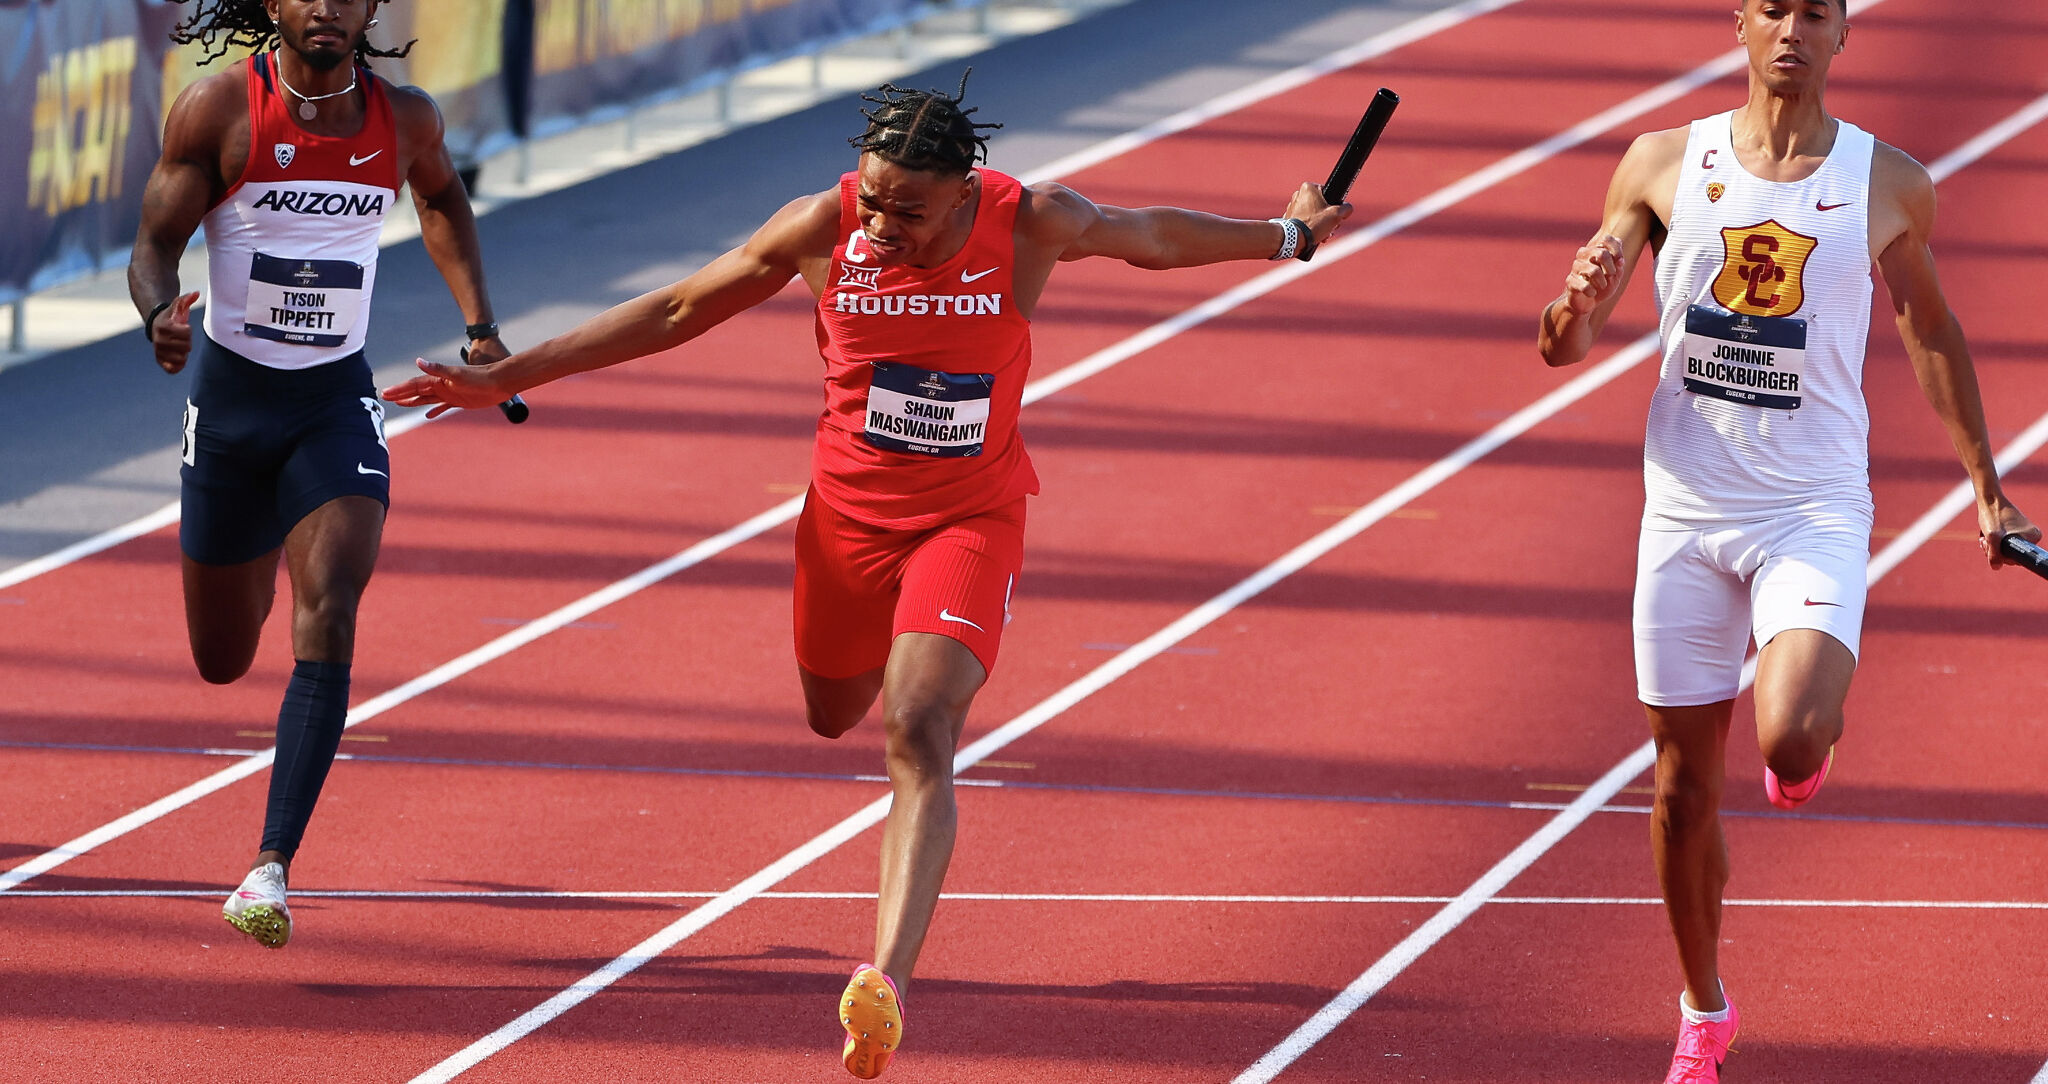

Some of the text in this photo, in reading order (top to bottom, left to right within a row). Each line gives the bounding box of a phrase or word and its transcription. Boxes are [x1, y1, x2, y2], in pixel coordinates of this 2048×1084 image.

[1702, 150, 1717, 169] C
[252, 190, 384, 216] ARIZONA
[845, 229, 867, 263] C
[283, 291, 326, 307] TYSON
[835, 292, 1002, 316] HOUSTON
[270, 307, 335, 330] TIPPETT
[1712, 344, 1775, 367] JOHNNIE
[1688, 356, 1799, 392] BLOCKBURGER
[1725, 389, 1756, 401] EUGENE, OR
[904, 400, 955, 421] SHAUN
[869, 410, 983, 442] MASWANGANYI
[907, 443, 930, 453] EUGENE,
